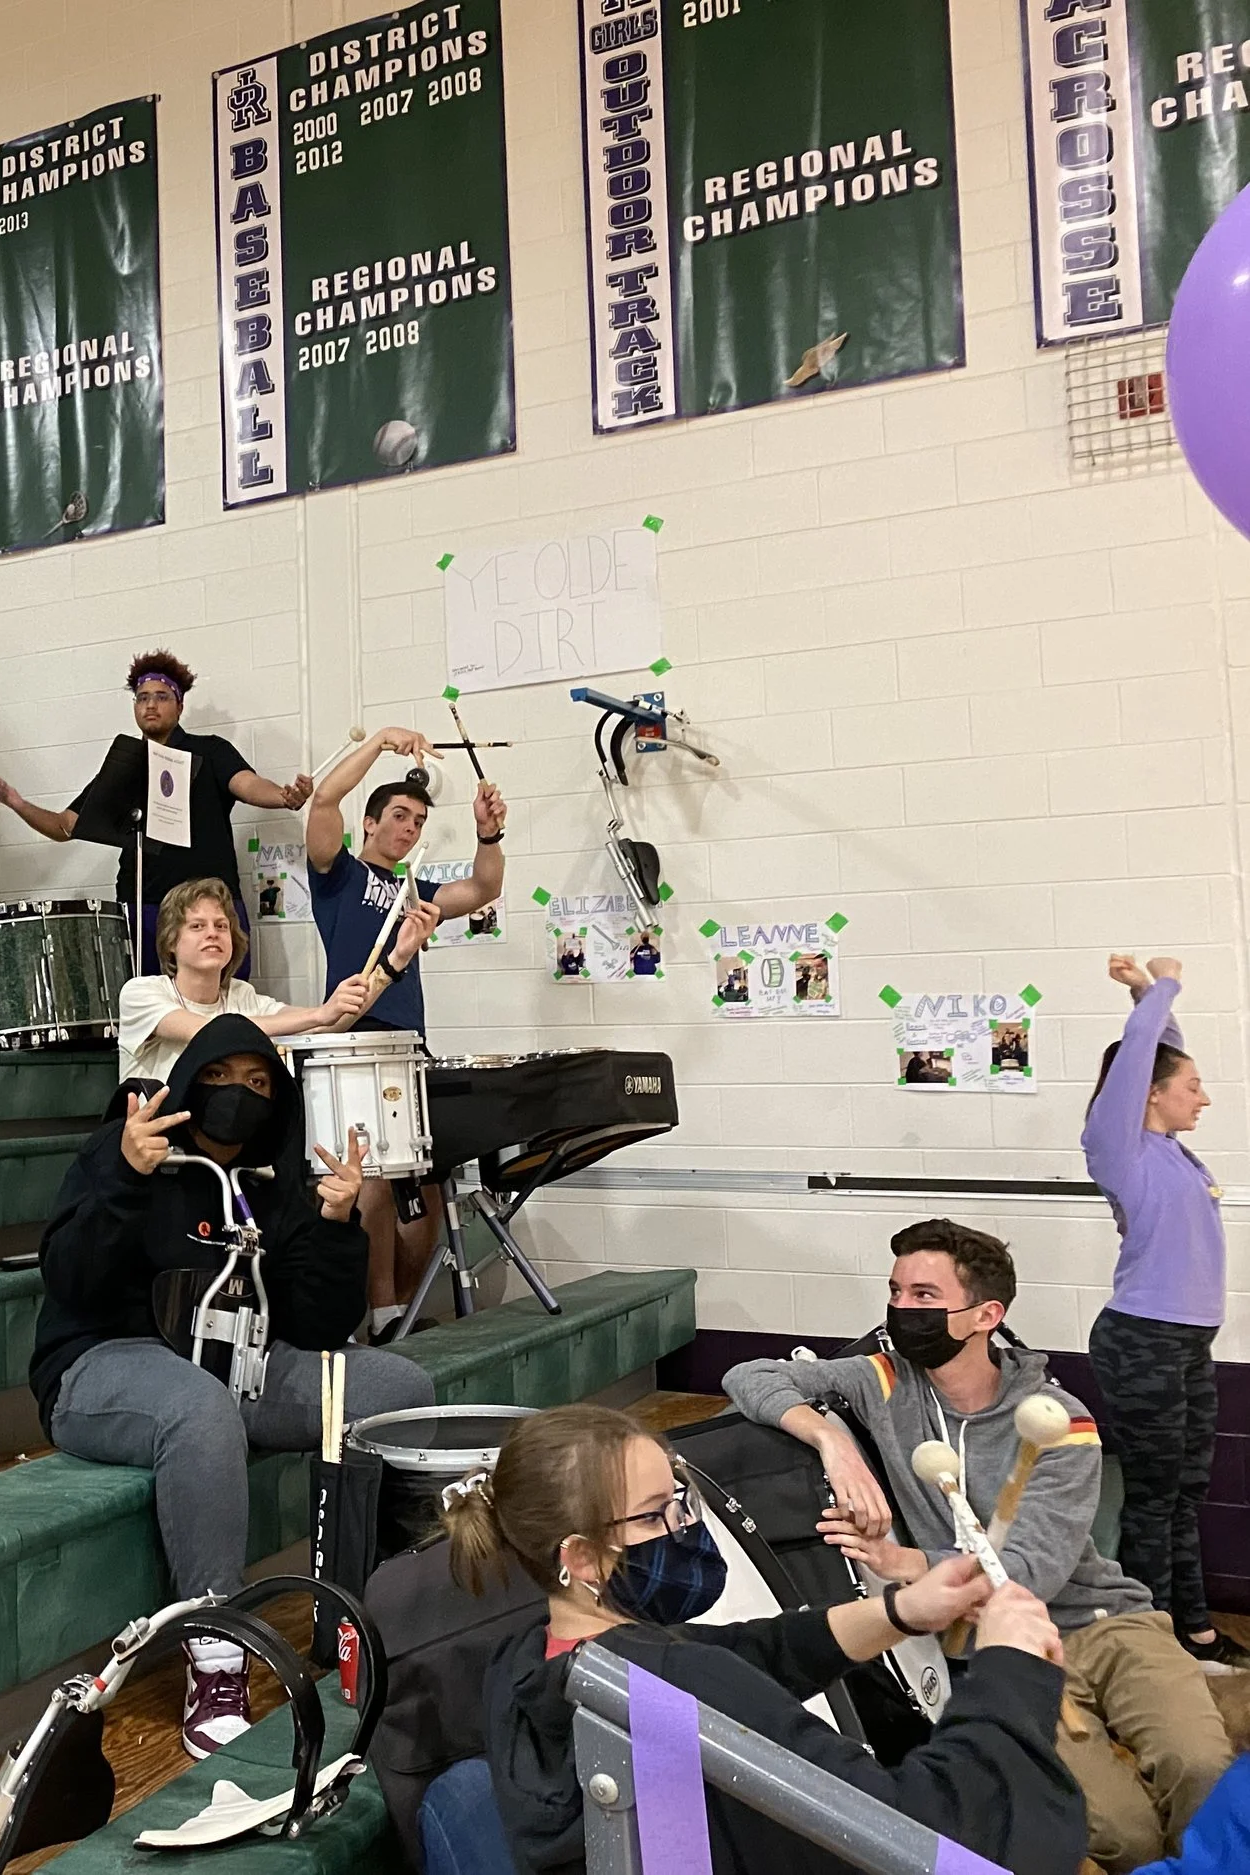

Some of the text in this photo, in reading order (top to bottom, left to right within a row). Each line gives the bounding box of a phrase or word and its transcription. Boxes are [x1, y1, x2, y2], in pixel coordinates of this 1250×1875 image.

[309, 4, 461, 77] DISTRICT
[589, 7, 658, 54] GIRLS
[289, 30, 487, 112] CHAMPIONS
[293, 67, 482, 146] 2000 2007 2008
[2, 116, 124, 178] DISTRICT
[295, 140, 343, 175] 2012
[600, 50, 655, 260] OUTDOOR
[704, 128, 914, 206] REGIONAL
[683, 157, 940, 245] CHAMPIONS
[294, 266, 498, 338] CHAMPIONS
[311, 240, 478, 302] REGIONAL
[230, 137, 275, 490] BASEBALL
[298, 320, 419, 372] 2007 2008
[606, 262, 664, 419] TRACK
[0, 331, 135, 383] REGIONAL
[449, 529, 644, 612] YE OLDE
[494, 600, 606, 677] DIRT
[549, 895, 664, 917] ELIZABE
[720, 923, 820, 947] LEANNE
[914, 993, 1007, 1018] NIKO
